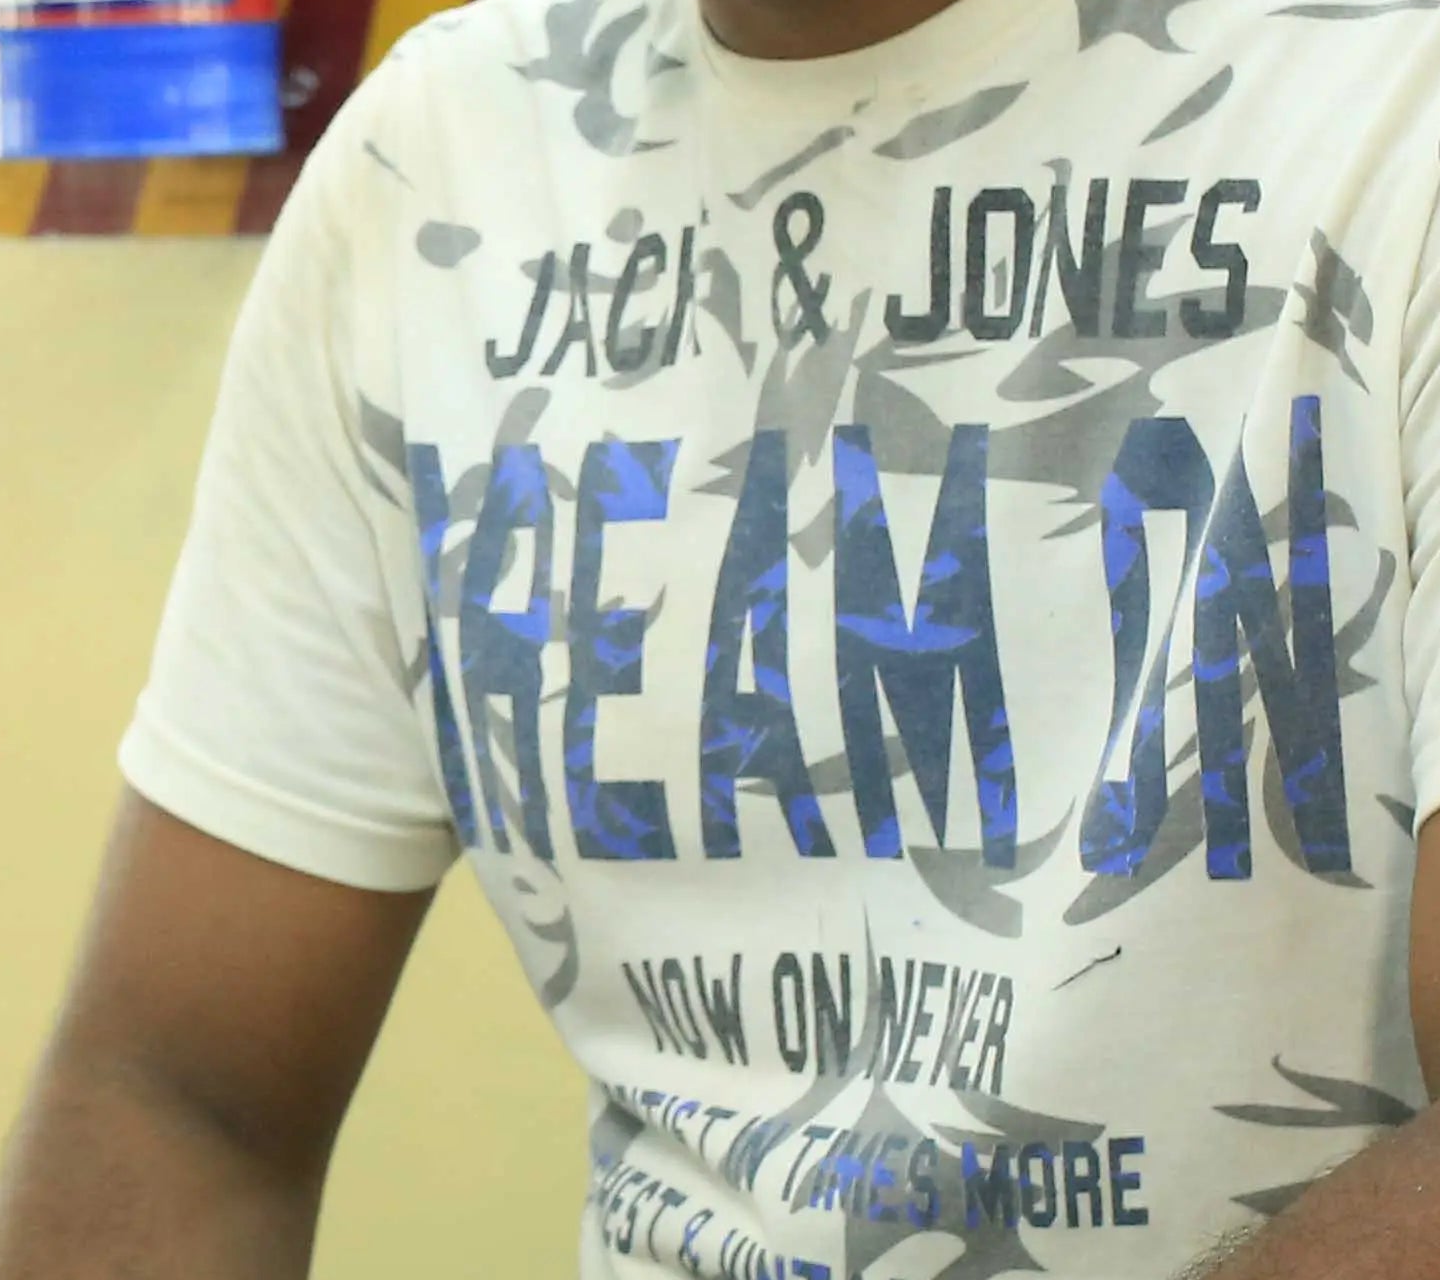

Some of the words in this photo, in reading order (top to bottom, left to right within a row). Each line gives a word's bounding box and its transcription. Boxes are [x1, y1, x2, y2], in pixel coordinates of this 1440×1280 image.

[772, 191, 832, 352] &
[884, 178, 1261, 342] JONES
[1080, 395, 1352, 880] ON
[622, 953, 749, 1067] NOW
[773, 952, 851, 1079] ON
[865, 956, 1015, 1097] NEVER
[961, 1136, 1149, 1229] MORE
